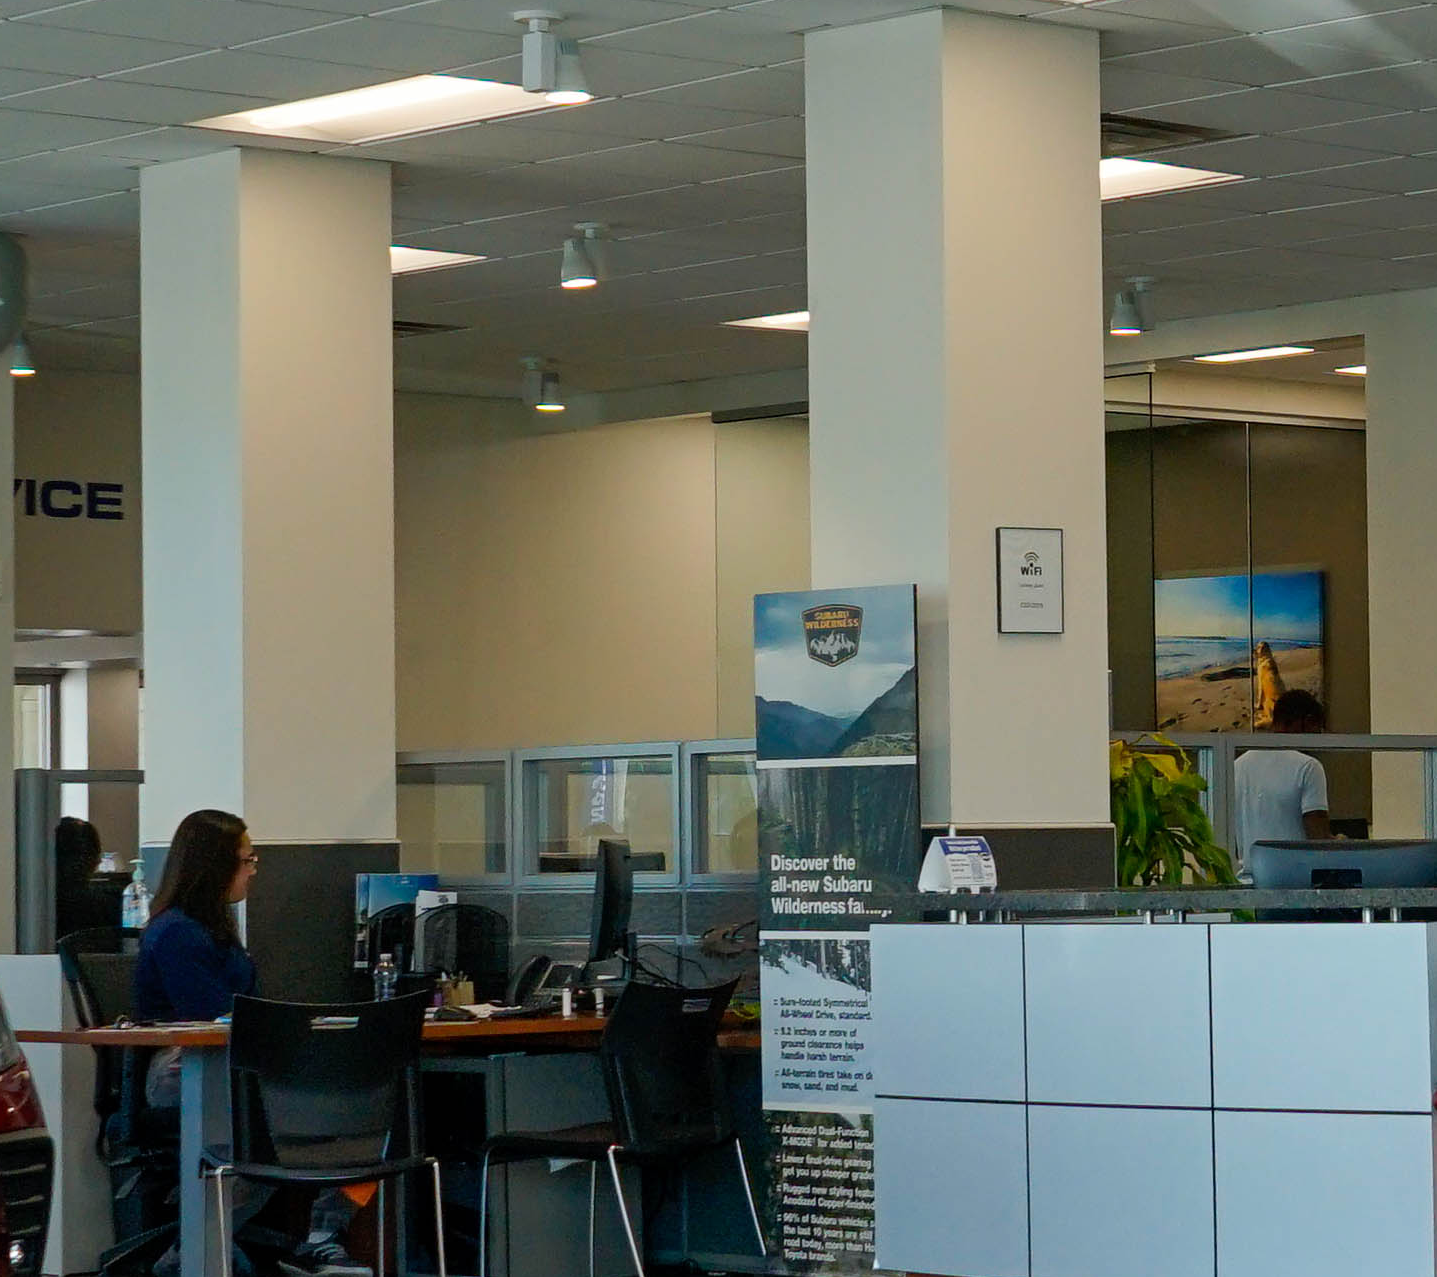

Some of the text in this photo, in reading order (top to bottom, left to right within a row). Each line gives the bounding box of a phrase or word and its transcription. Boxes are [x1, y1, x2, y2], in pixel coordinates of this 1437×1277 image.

[14, 479, 124, 520] ICE
[805, 618, 858, 629] WILDERNESS
[771, 854, 856, 871] Discover the
[771, 875, 872, 892] all-new Subaru
[771, 897, 846, 914] Wilderness
